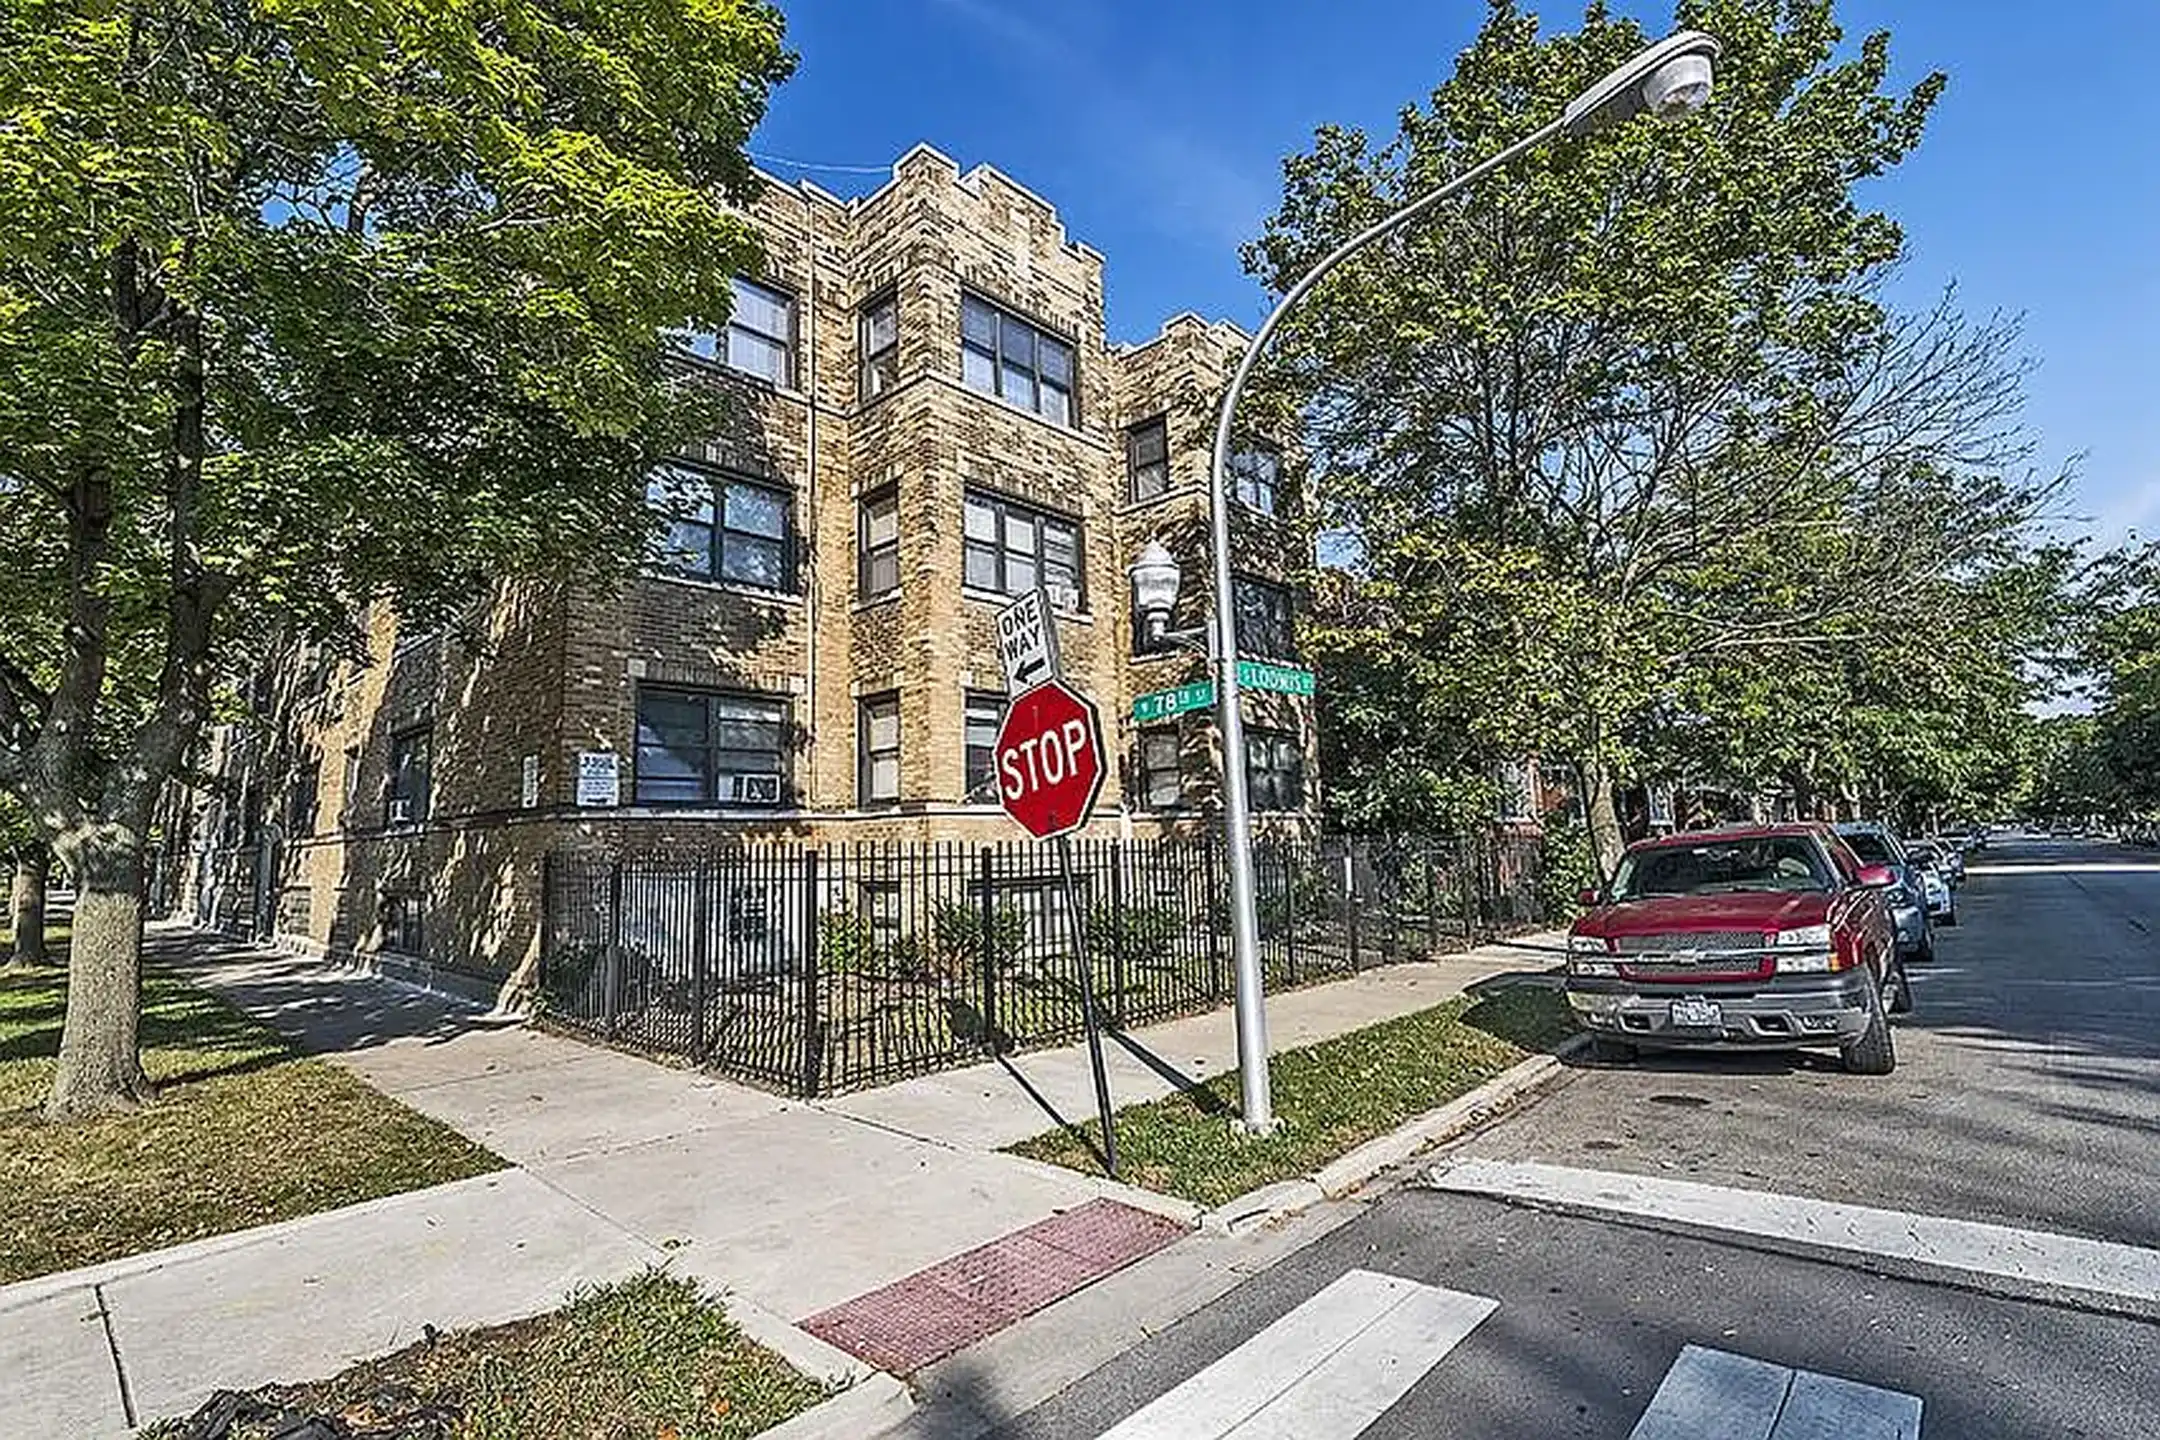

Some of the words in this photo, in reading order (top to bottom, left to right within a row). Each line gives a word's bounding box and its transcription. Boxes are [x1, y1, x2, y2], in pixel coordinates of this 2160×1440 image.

[1002, 599, 1038, 636] ONE
[1004, 622, 1040, 661] WAY
[1002, 719, 1086, 800] STOP
